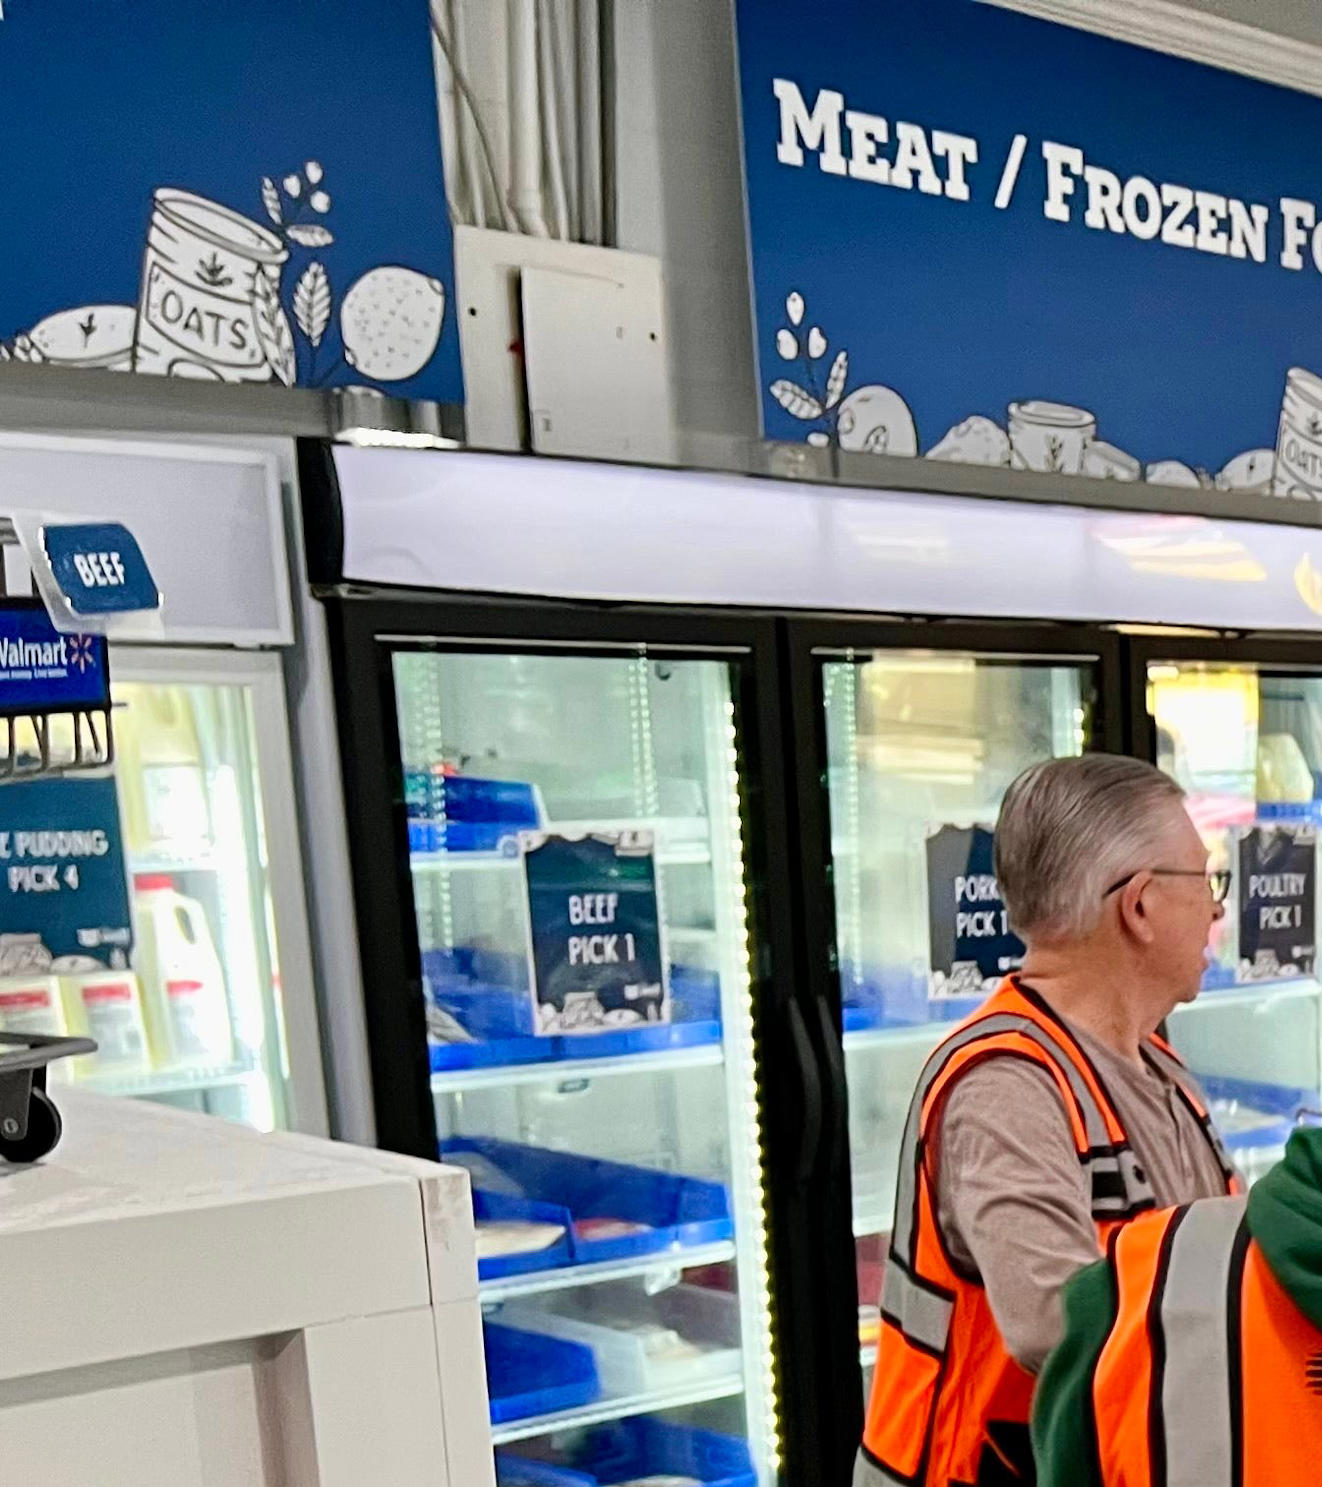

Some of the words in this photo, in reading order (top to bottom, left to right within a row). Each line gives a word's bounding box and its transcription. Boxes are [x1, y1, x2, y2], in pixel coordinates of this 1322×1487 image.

[159, 289, 250, 350] OATS
[74, 552, 125, 587] BEEF
[14, 830, 109, 857] PUDDING
[8, 864, 60, 892] PICK
[64, 864, 79, 890] 4
[954, 874, 1000, 903] PORK
[1249, 873, 1306, 898] POULTRY
[568, 892, 618, 925] BEEF
[1259, 905, 1292, 930] PICK
[1294, 903, 1302, 928] 1
[956, 910, 996, 937] PICK
[1000, 909, 1008, 935] 1
[568, 934, 620, 965] PICK
[625, 932, 636, 961] 1
